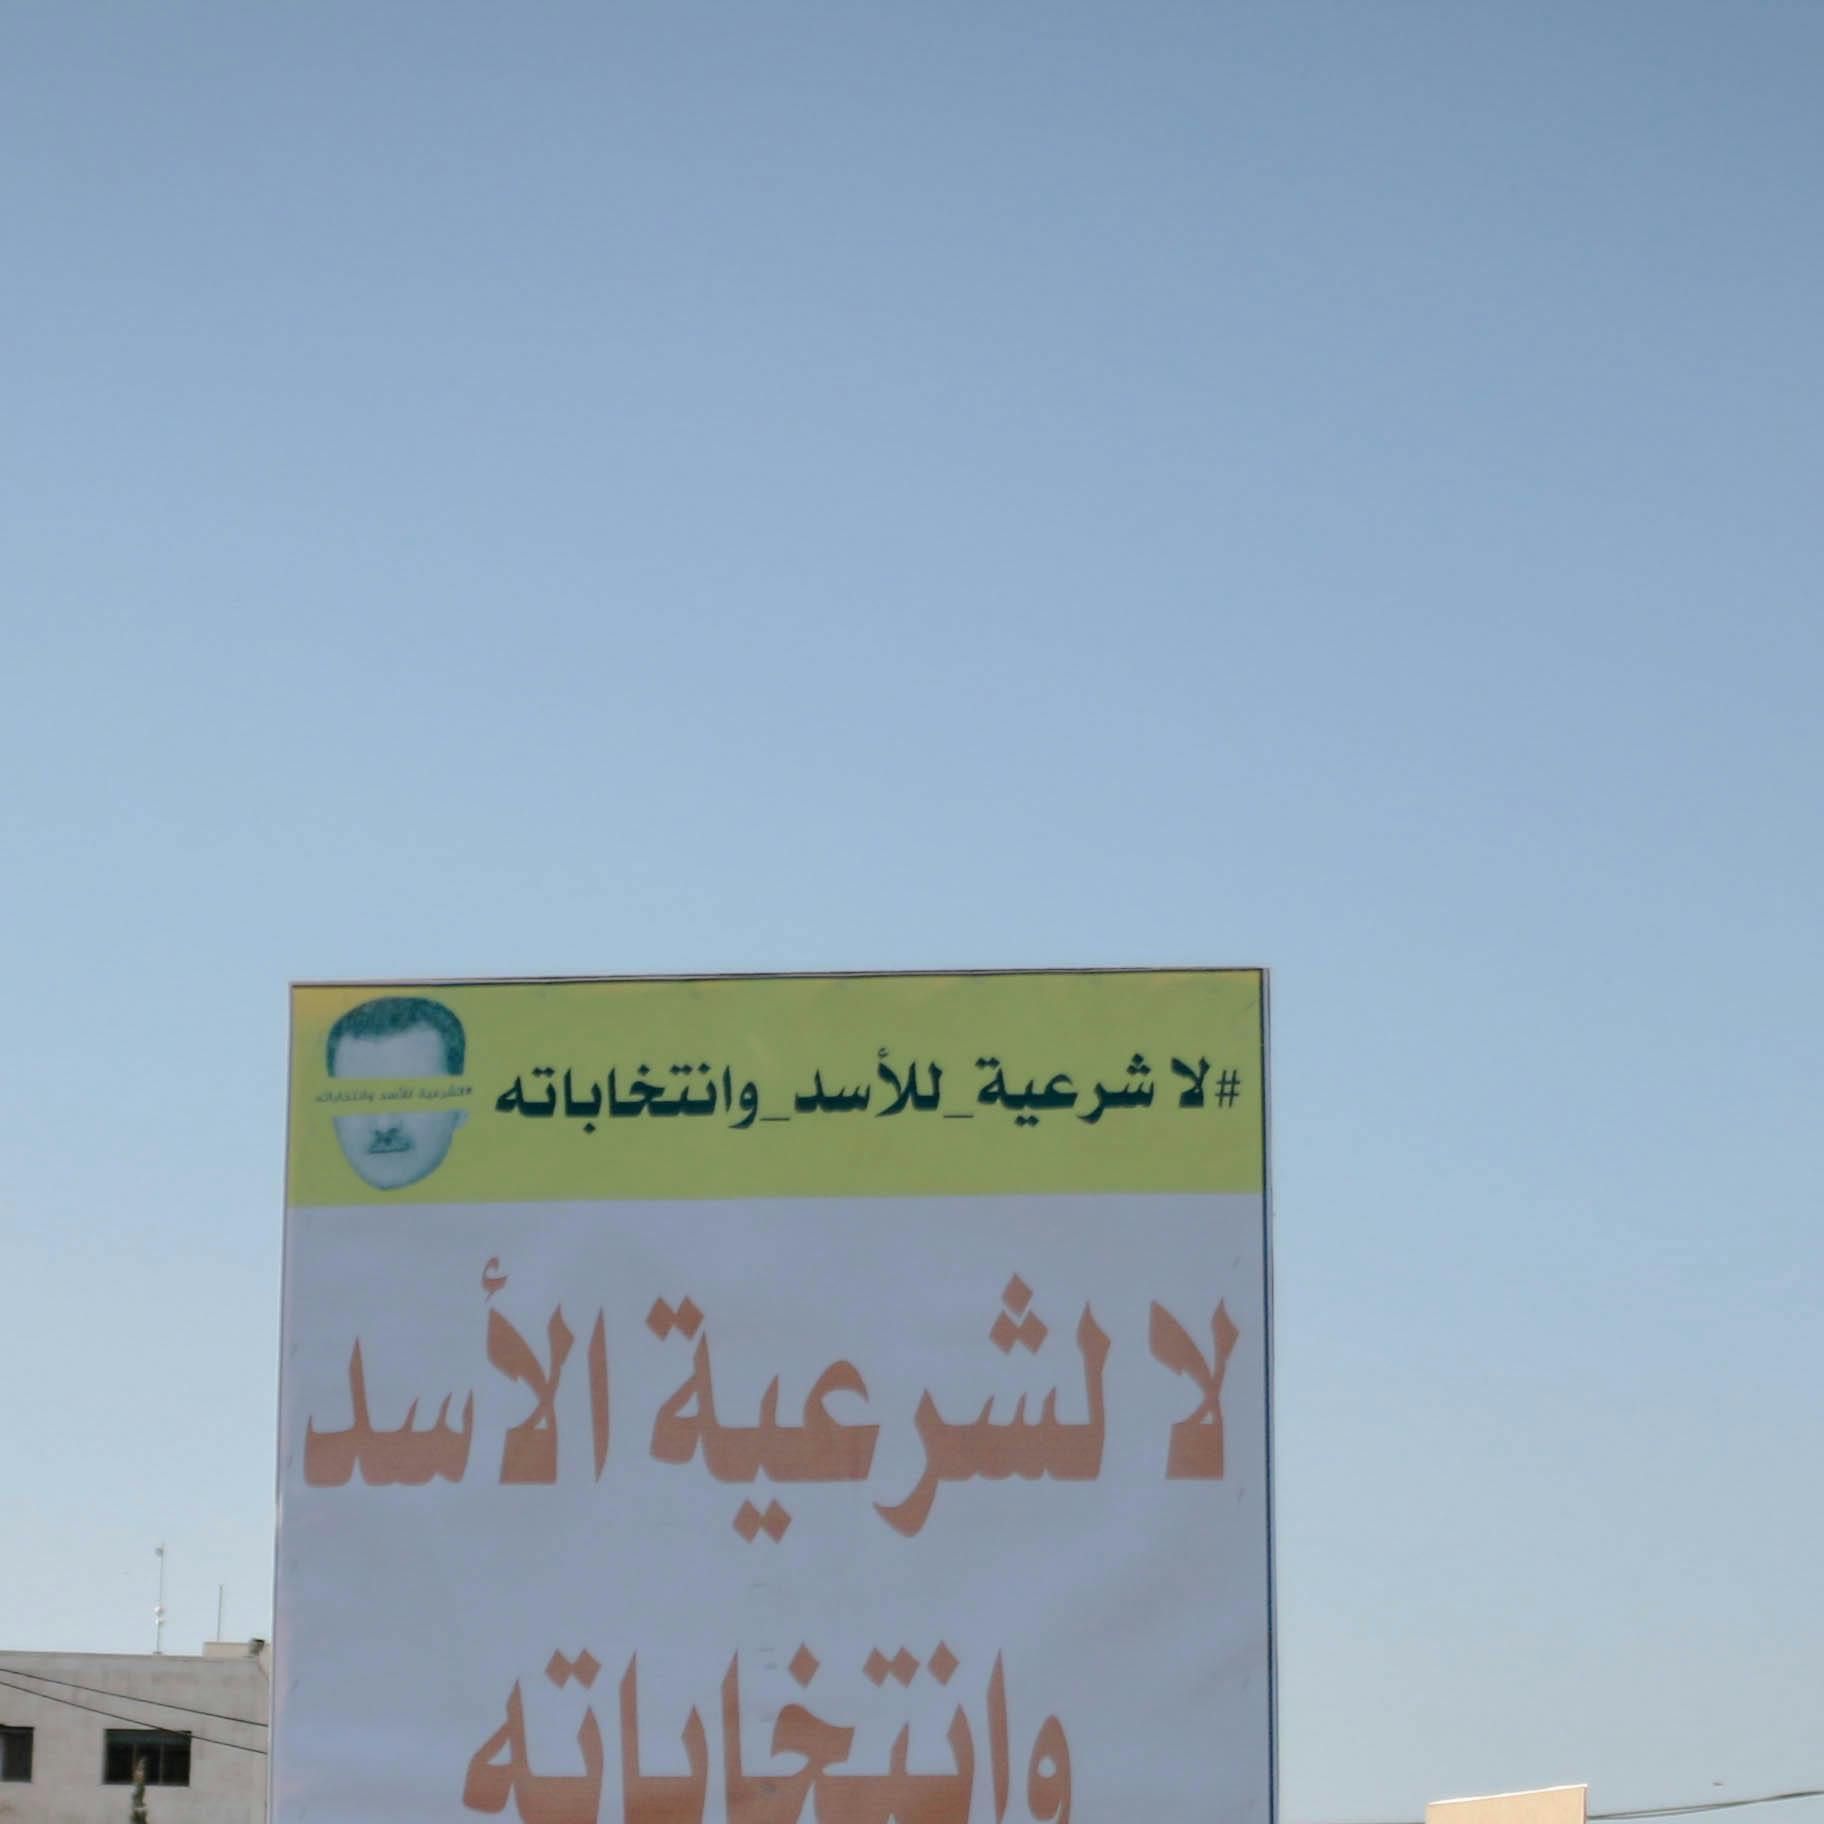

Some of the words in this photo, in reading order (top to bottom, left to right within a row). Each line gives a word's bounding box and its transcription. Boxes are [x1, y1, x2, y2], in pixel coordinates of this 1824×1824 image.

[302, 1256, 610, 1488] الأسد
[644, 1272, 1112, 1544] لشرعية
[1148, 1296, 1241, 1480] لا
